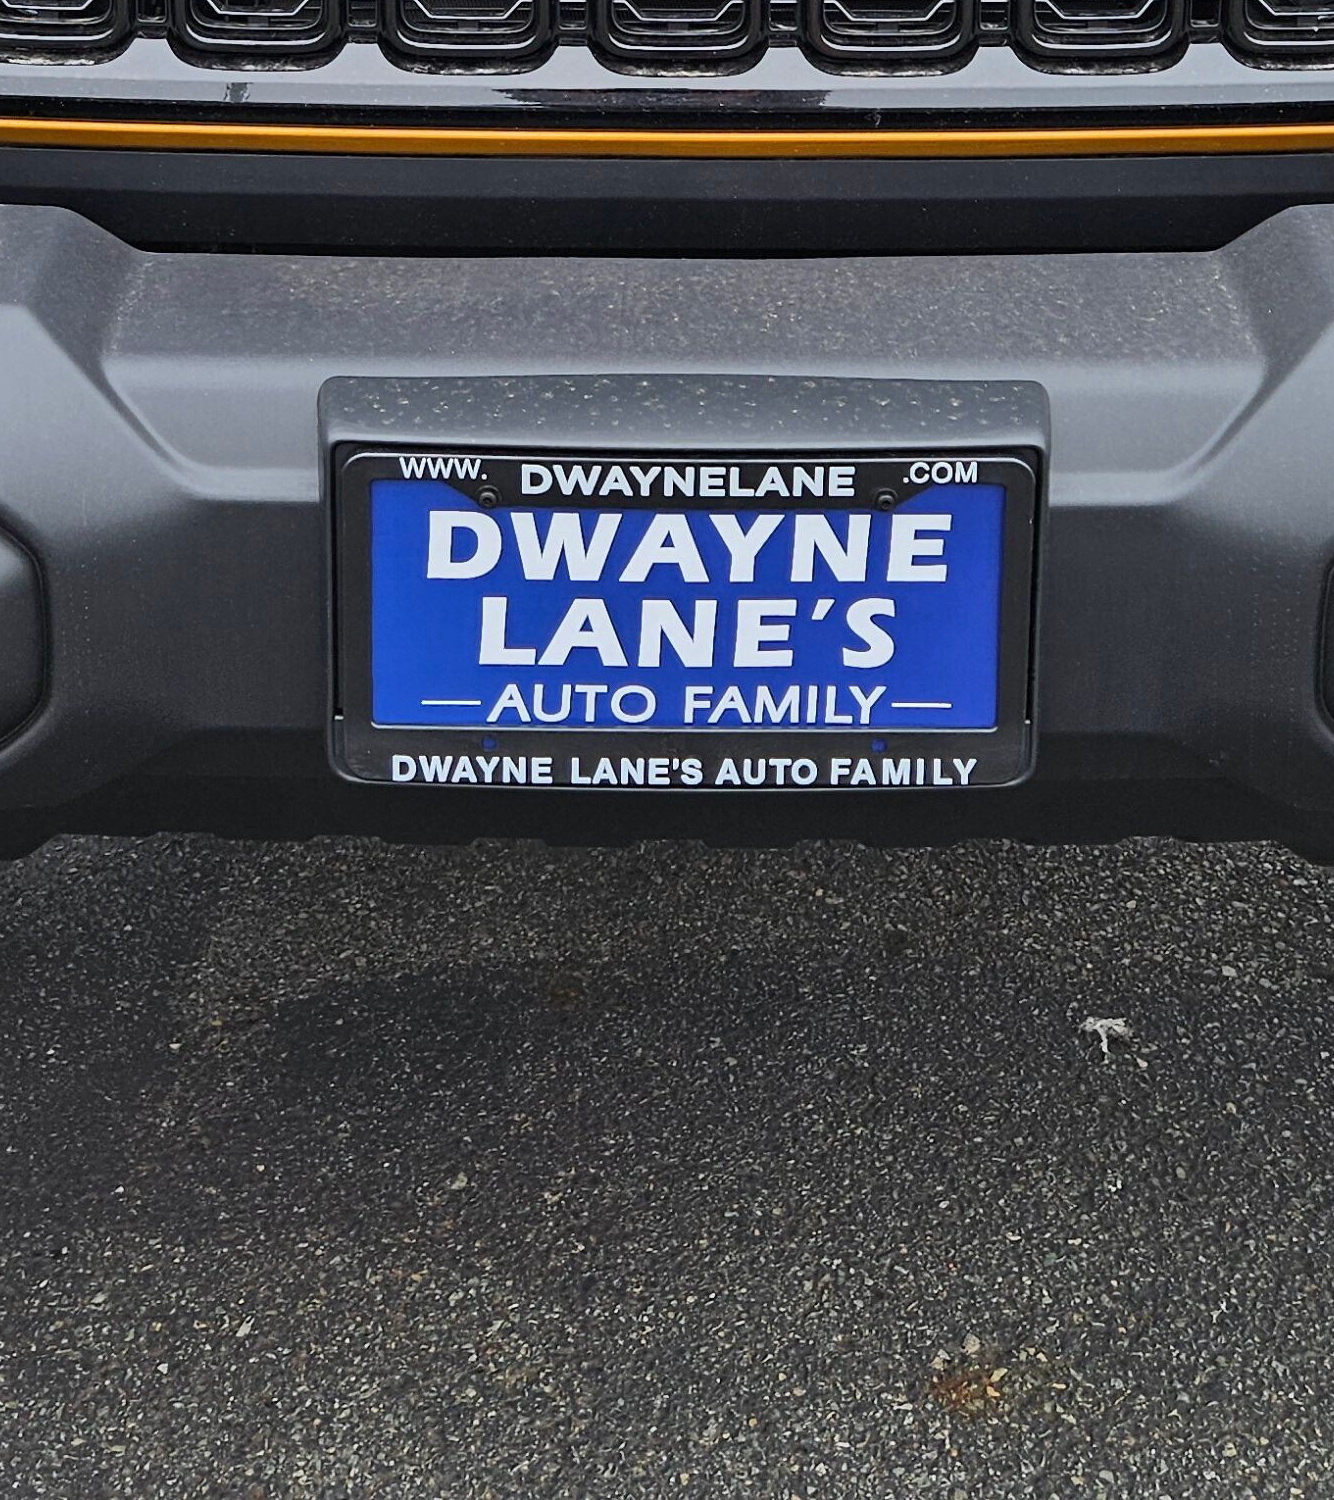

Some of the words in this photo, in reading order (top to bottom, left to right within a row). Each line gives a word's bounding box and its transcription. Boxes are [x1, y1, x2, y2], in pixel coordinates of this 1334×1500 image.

[521, 464, 856, 497] DWAYNELANE
[902, 460, 978, 484] .COM
[426, 510, 952, 583] DWAYNE
[478, 596, 895, 668] LANE'S
[486, 683, 656, 723] AUTO
[684, 685, 886, 724] FAMILY
[392, 755, 553, 785] DWAYNE
[570, 757, 703, 786] LANE'S
[714, 758, 818, 786] AUTO
[830, 757, 978, 787] FAMILY
